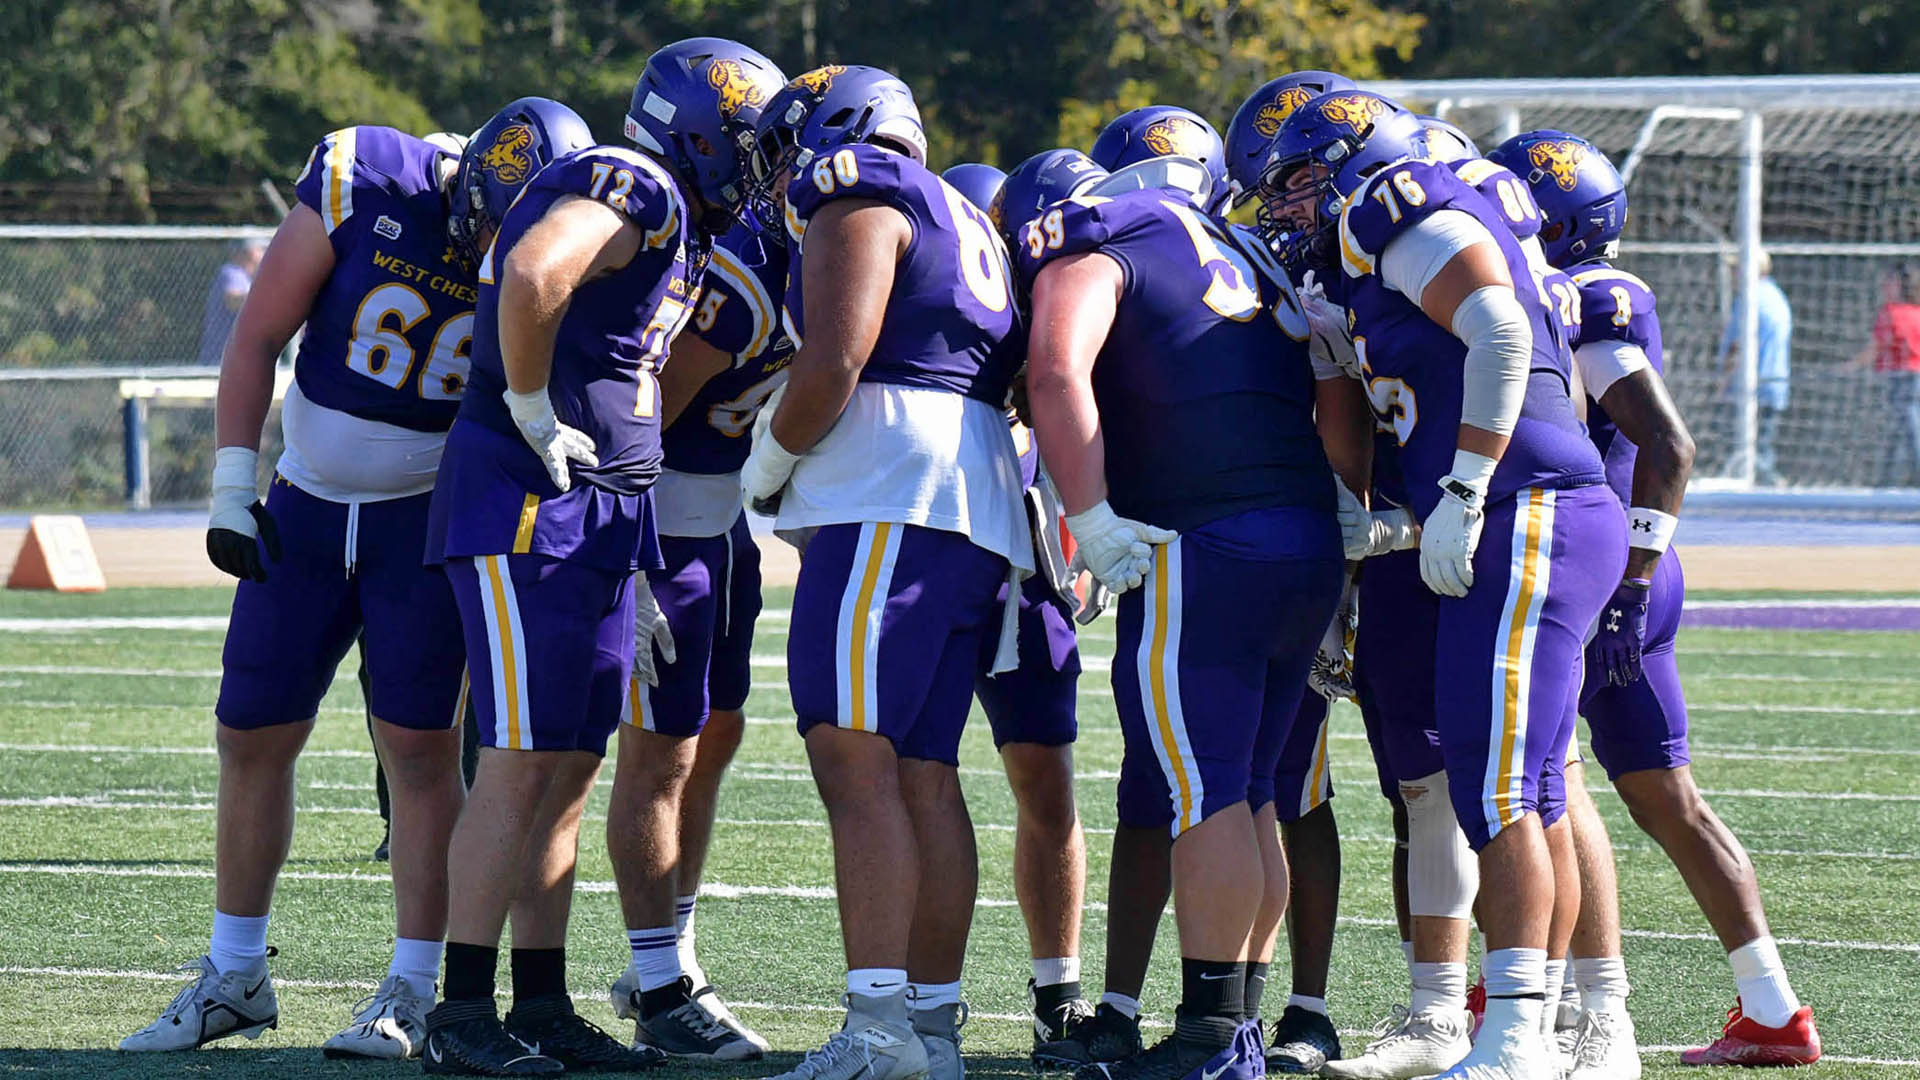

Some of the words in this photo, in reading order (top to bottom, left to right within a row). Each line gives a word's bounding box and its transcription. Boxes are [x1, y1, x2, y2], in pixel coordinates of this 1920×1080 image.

[590, 162, 635, 213] 72
[812, 149, 859, 194] 60
[1371, 170, 1427, 224] 76
[372, 249, 430, 282] WEST
